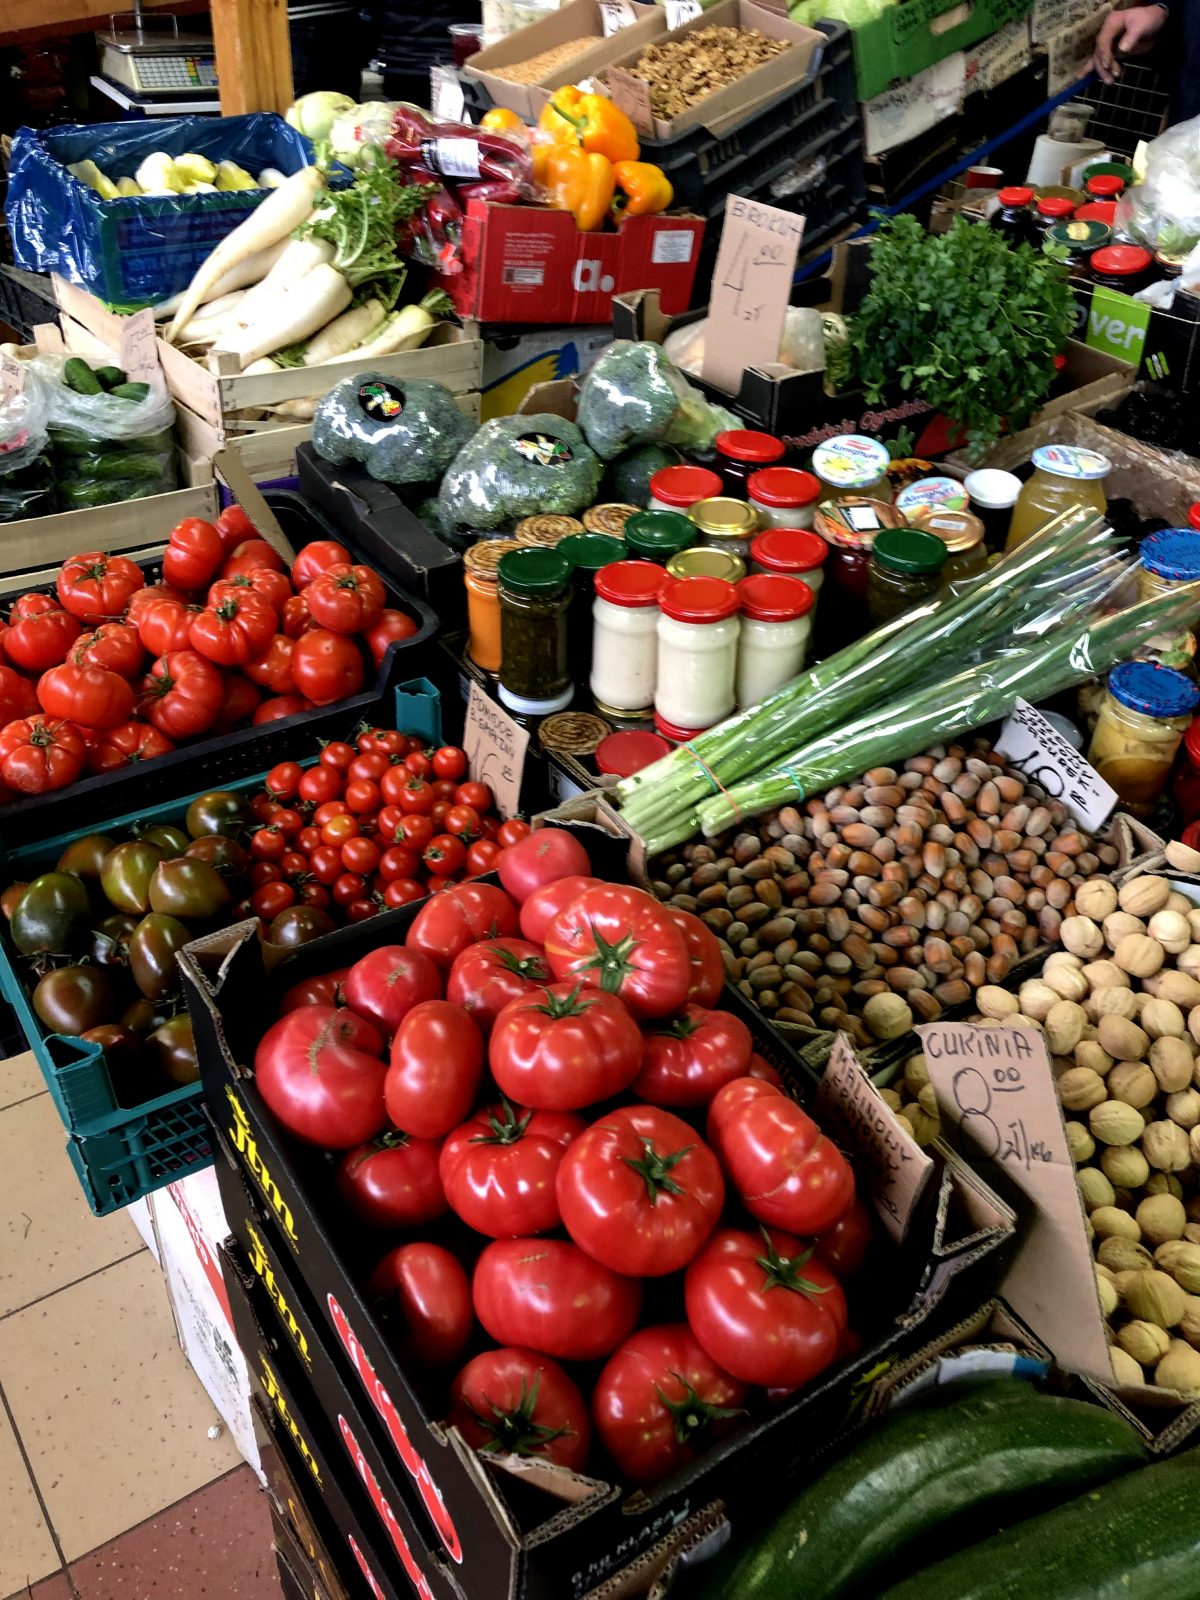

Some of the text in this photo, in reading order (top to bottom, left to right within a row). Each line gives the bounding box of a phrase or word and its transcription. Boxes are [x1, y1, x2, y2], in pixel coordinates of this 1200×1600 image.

[926, 1031, 1033, 1060] CUKINIA
[835, 1046, 914, 1162] MALINOWY
[952, 1067, 1002, 1159] 8
